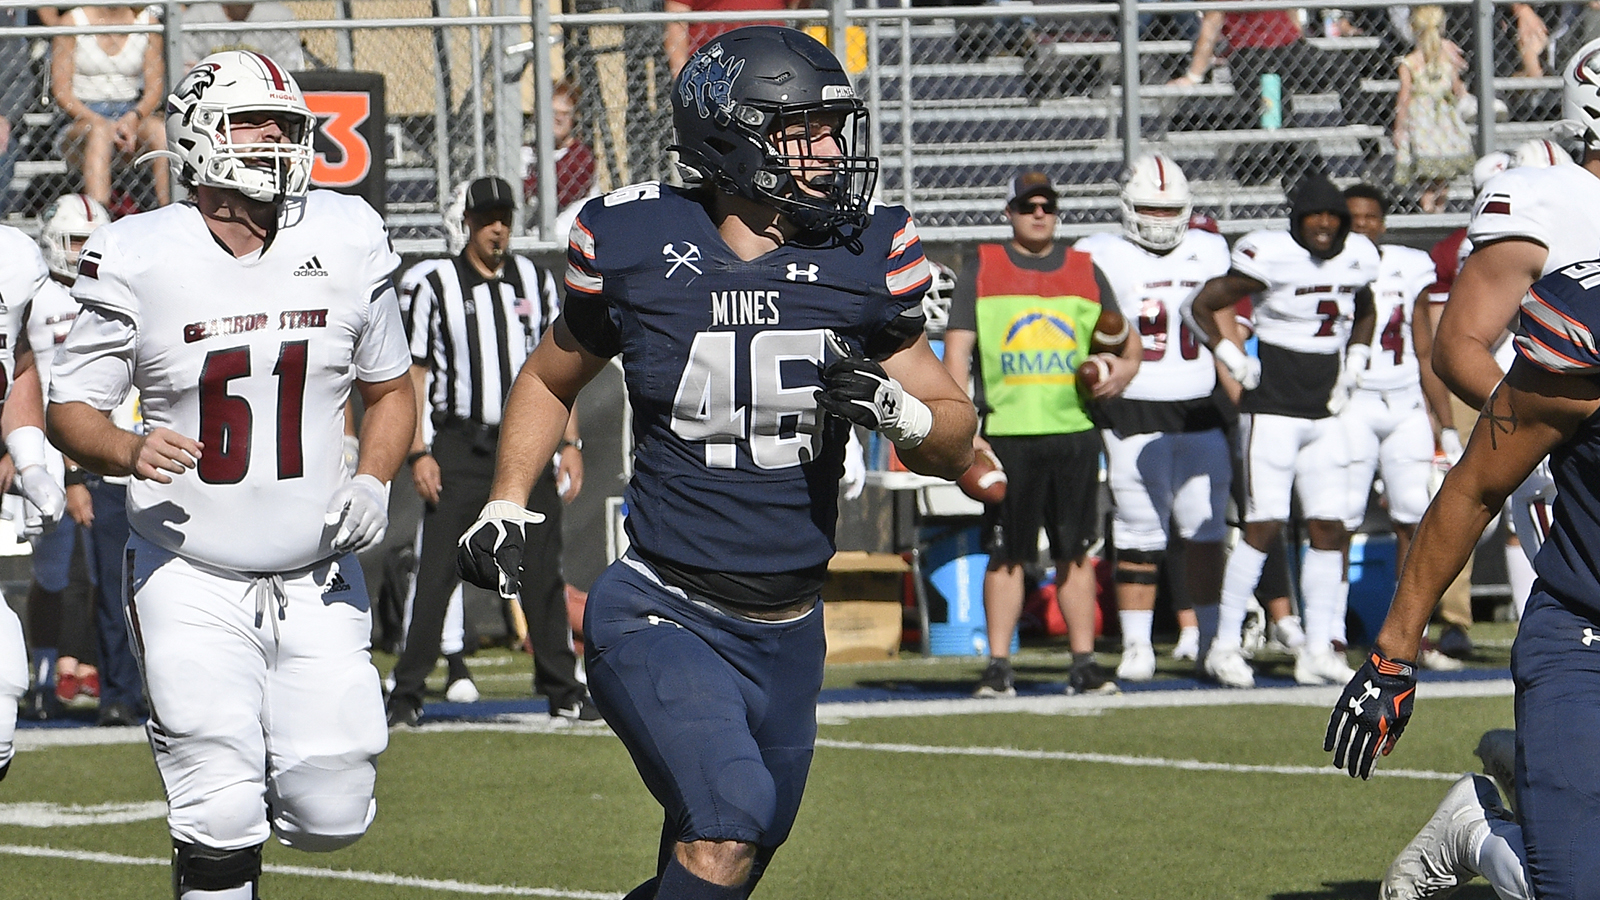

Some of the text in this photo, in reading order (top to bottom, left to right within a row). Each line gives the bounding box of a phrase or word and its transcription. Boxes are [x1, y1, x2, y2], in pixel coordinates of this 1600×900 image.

[302, 91, 372, 188] 3
[293, 269, 329, 277] adidas
[710, 291, 780, 326] MINES
[197, 339, 309, 485] 61
[670, 328, 825, 470] 46
